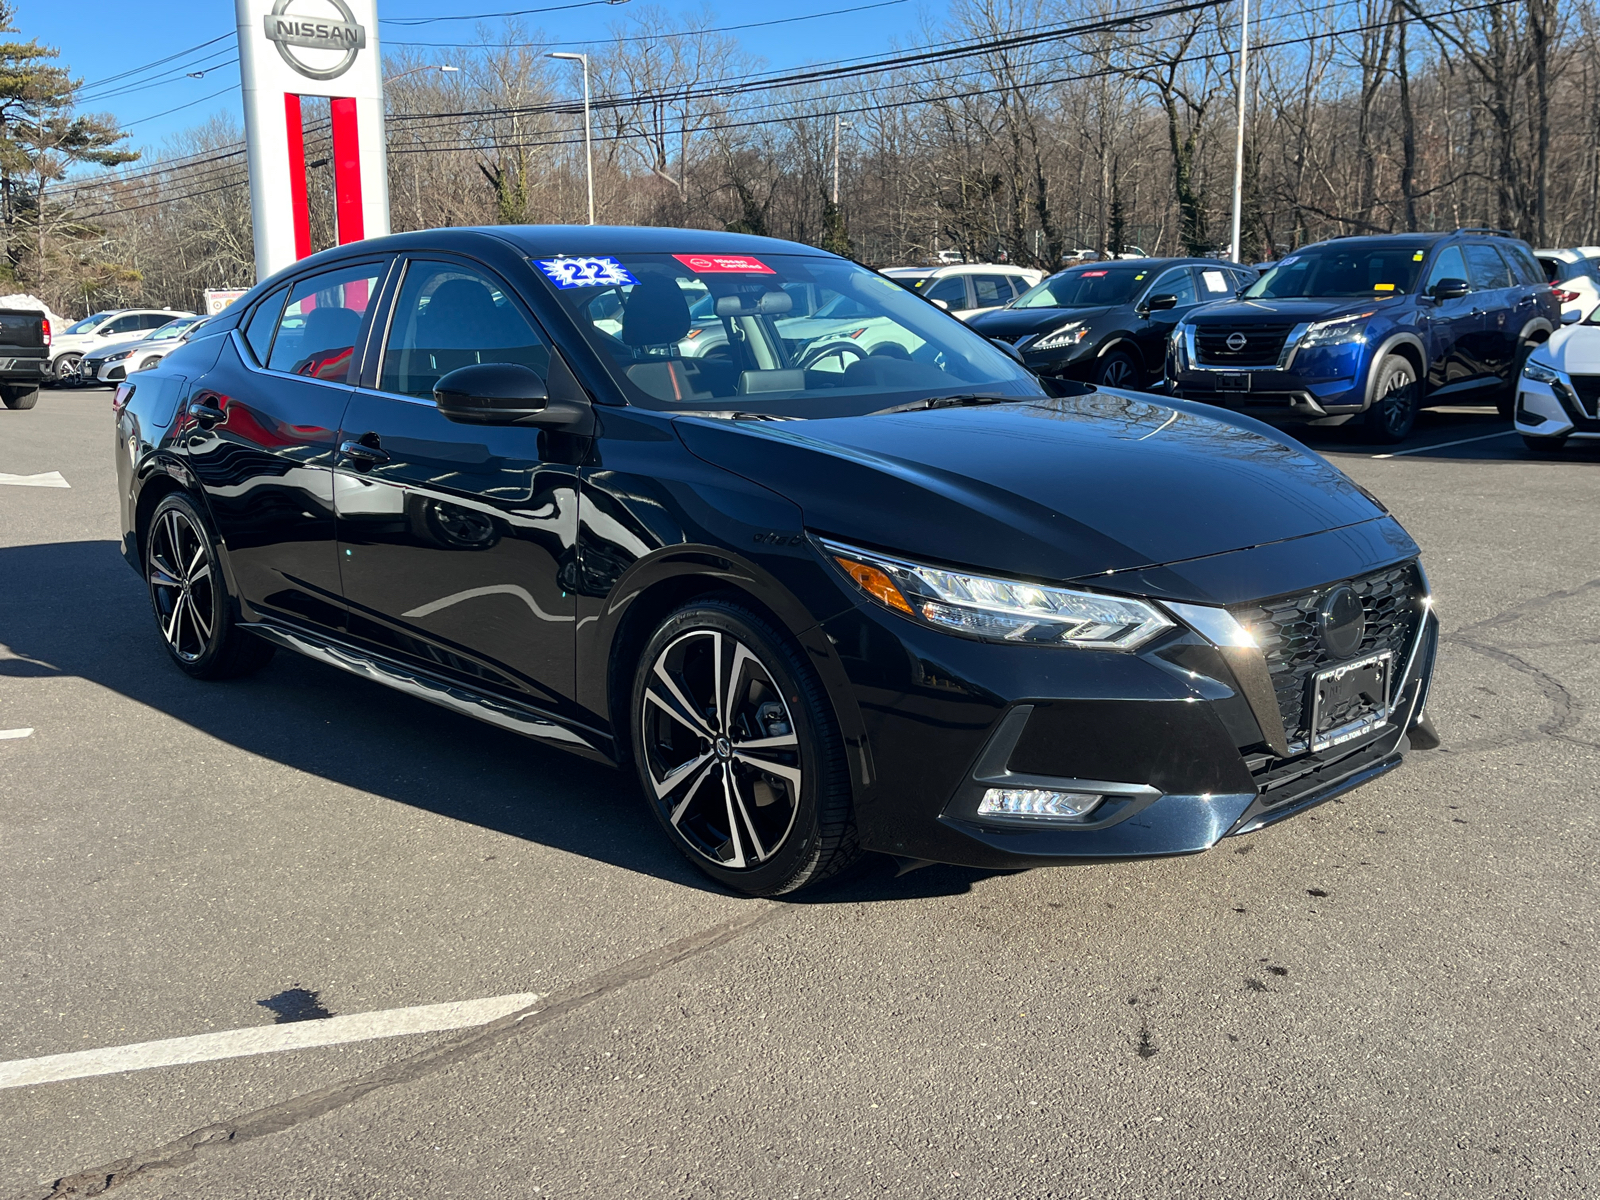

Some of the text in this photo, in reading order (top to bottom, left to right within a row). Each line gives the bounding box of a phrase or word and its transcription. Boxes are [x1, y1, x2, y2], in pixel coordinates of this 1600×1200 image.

[276, 20, 358, 43] NISSAN
[562, 262, 612, 280] 22
[1362, 725, 1371, 734] CT
